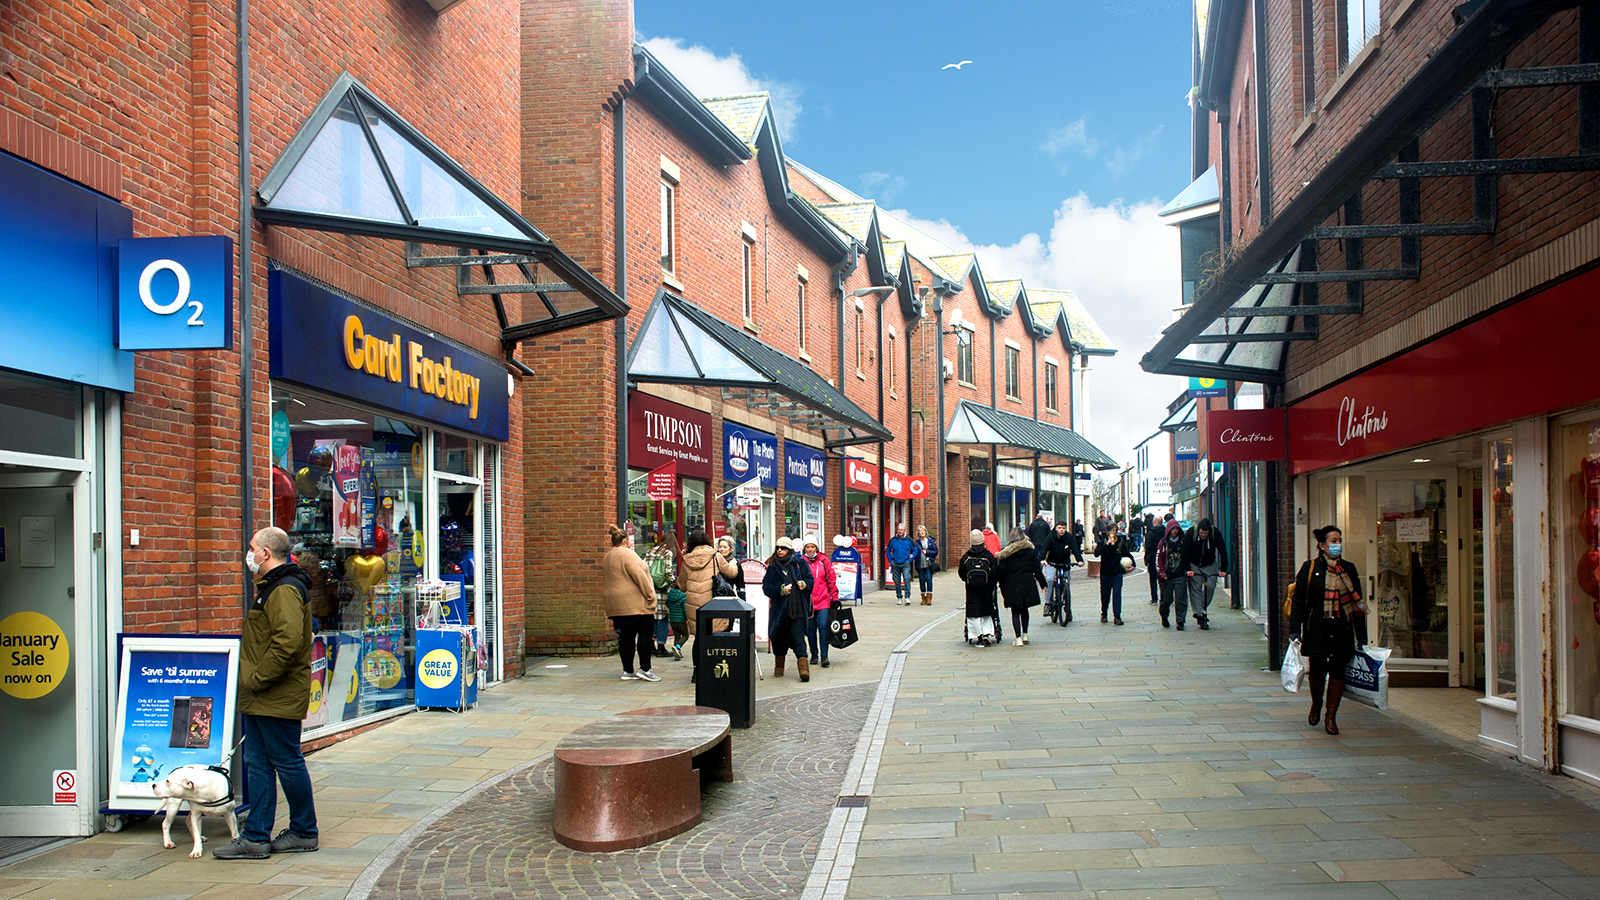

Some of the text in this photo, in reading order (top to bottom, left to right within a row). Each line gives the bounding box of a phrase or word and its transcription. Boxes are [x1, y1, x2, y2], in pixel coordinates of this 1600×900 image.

[139, 259, 204, 326] O2
[344, 315, 480, 419] Card Factory
[644, 410, 702, 449] TIMPSON
[1338, 396, 1388, 447] Clintons
[1220, 428, 1274, 444] Clintons
[647, 443, 658, 453] Great
[659, 446, 672, 456] Service
[673, 449, 678, 459] by
[679, 450, 688, 459] Great
[689, 452, 700, 463] People
[729, 435, 749, 460] MAX
[753, 440, 775, 460] The Photo
[1177, 445, 1197, 453] Clarks
[757, 462, 771, 482] Expert
[788, 455, 807, 478] Portraits
[810, 458, 824, 477] MAX
[11, 650, 45, 666] Sale
[706, 648, 738, 656] LITTER
[141, 667, 163, 676] Save
[178, 668, 217, 677] summer
[424, 661, 452, 669] GREAT
[425, 669, 452, 677] VALUE
[5, 675, 52, 684] now on
[1345, 667, 1375, 683] ESPASS
